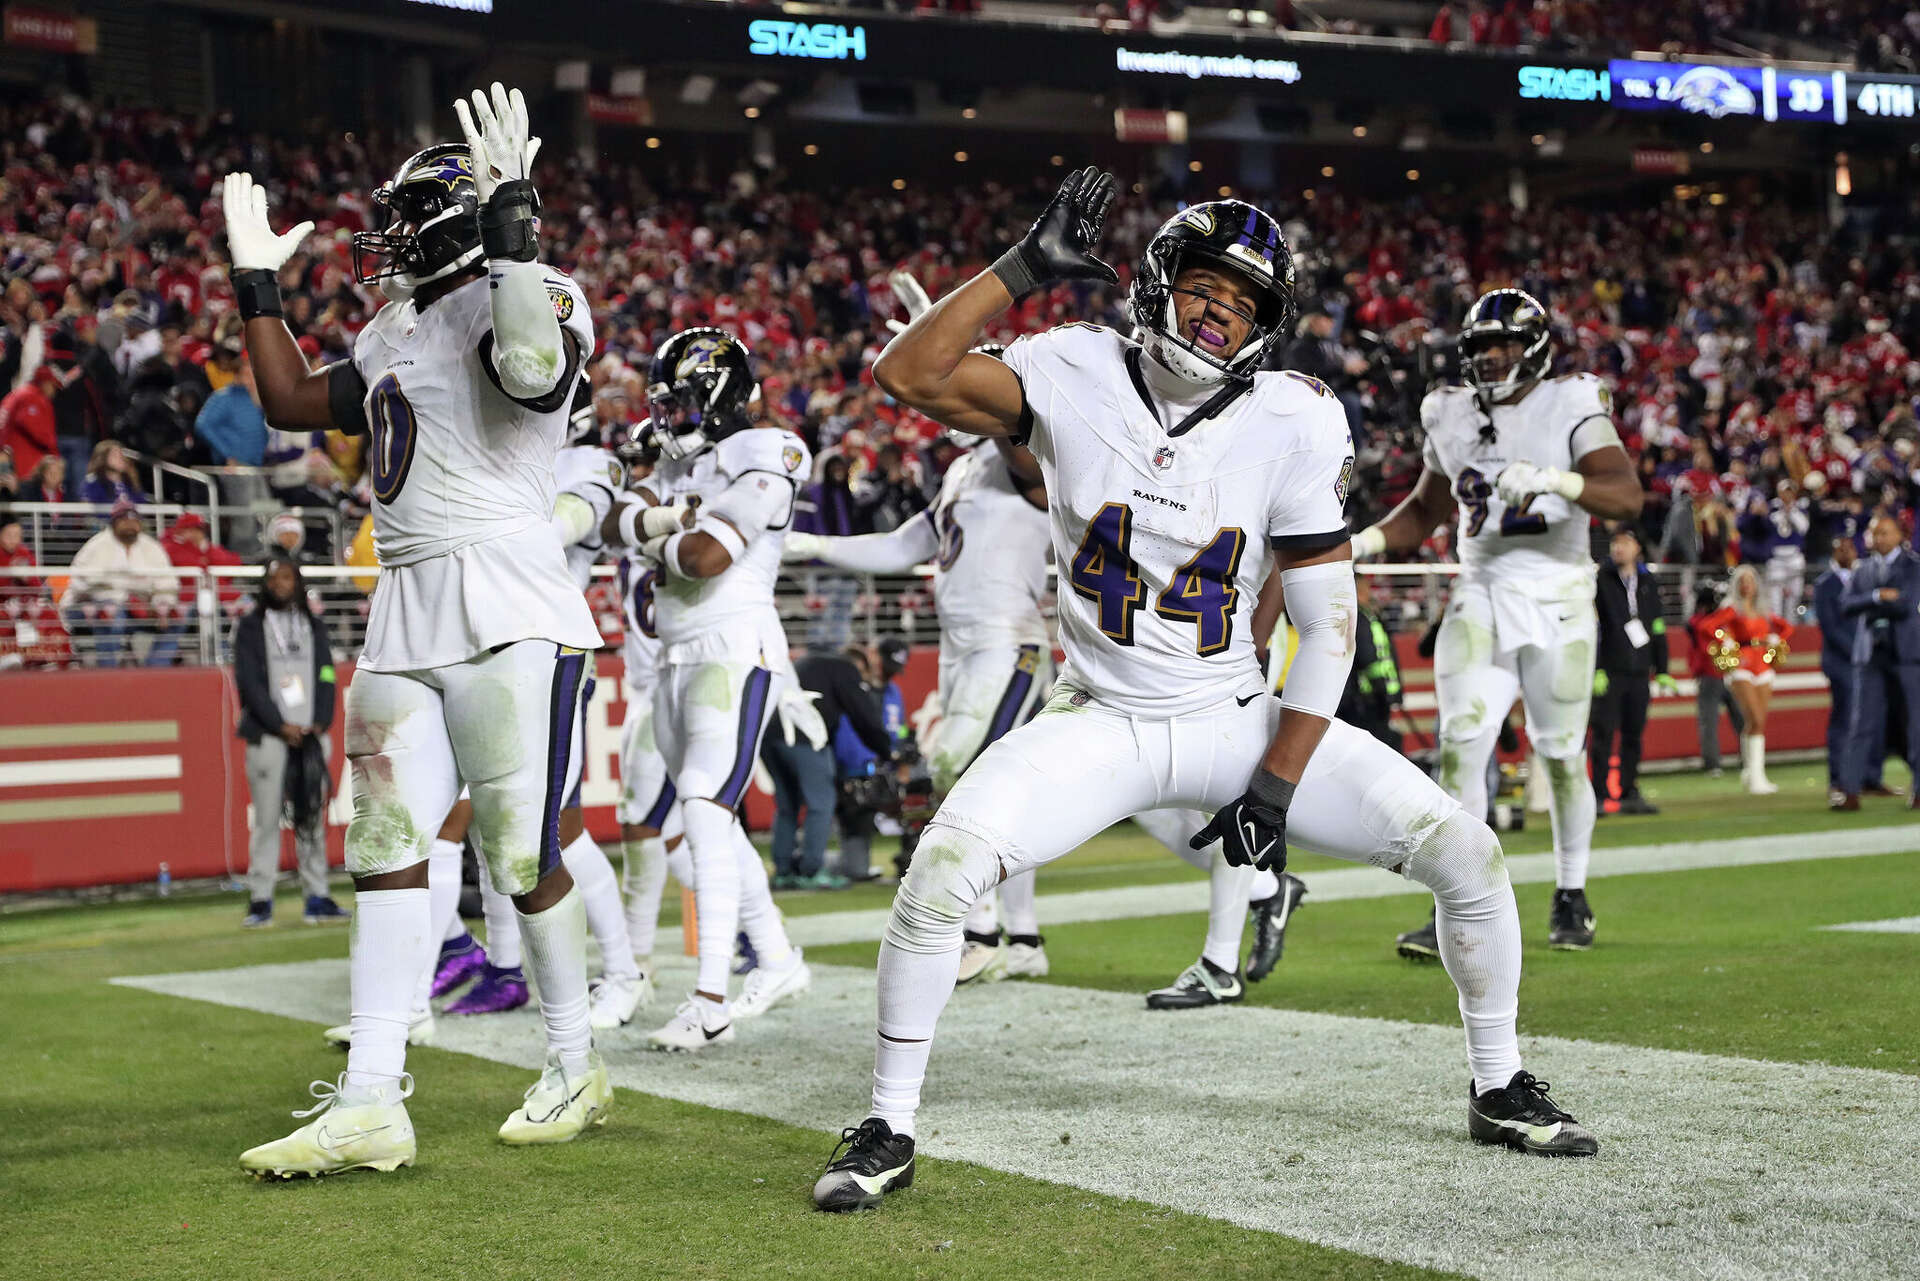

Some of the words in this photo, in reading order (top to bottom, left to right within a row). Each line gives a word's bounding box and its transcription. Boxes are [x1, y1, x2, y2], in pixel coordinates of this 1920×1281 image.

[748, 19, 867, 60] STASH
[1116, 47, 1200, 79] Investing
[1201, 54, 1254, 78] made
[1518, 66, 1612, 102] STASH
[1788, 78, 1824, 113] 33
[1857, 82, 1915, 118] 4TH
[1132, 488, 1188, 513] RAVENS
[1070, 500, 1247, 659] 44
